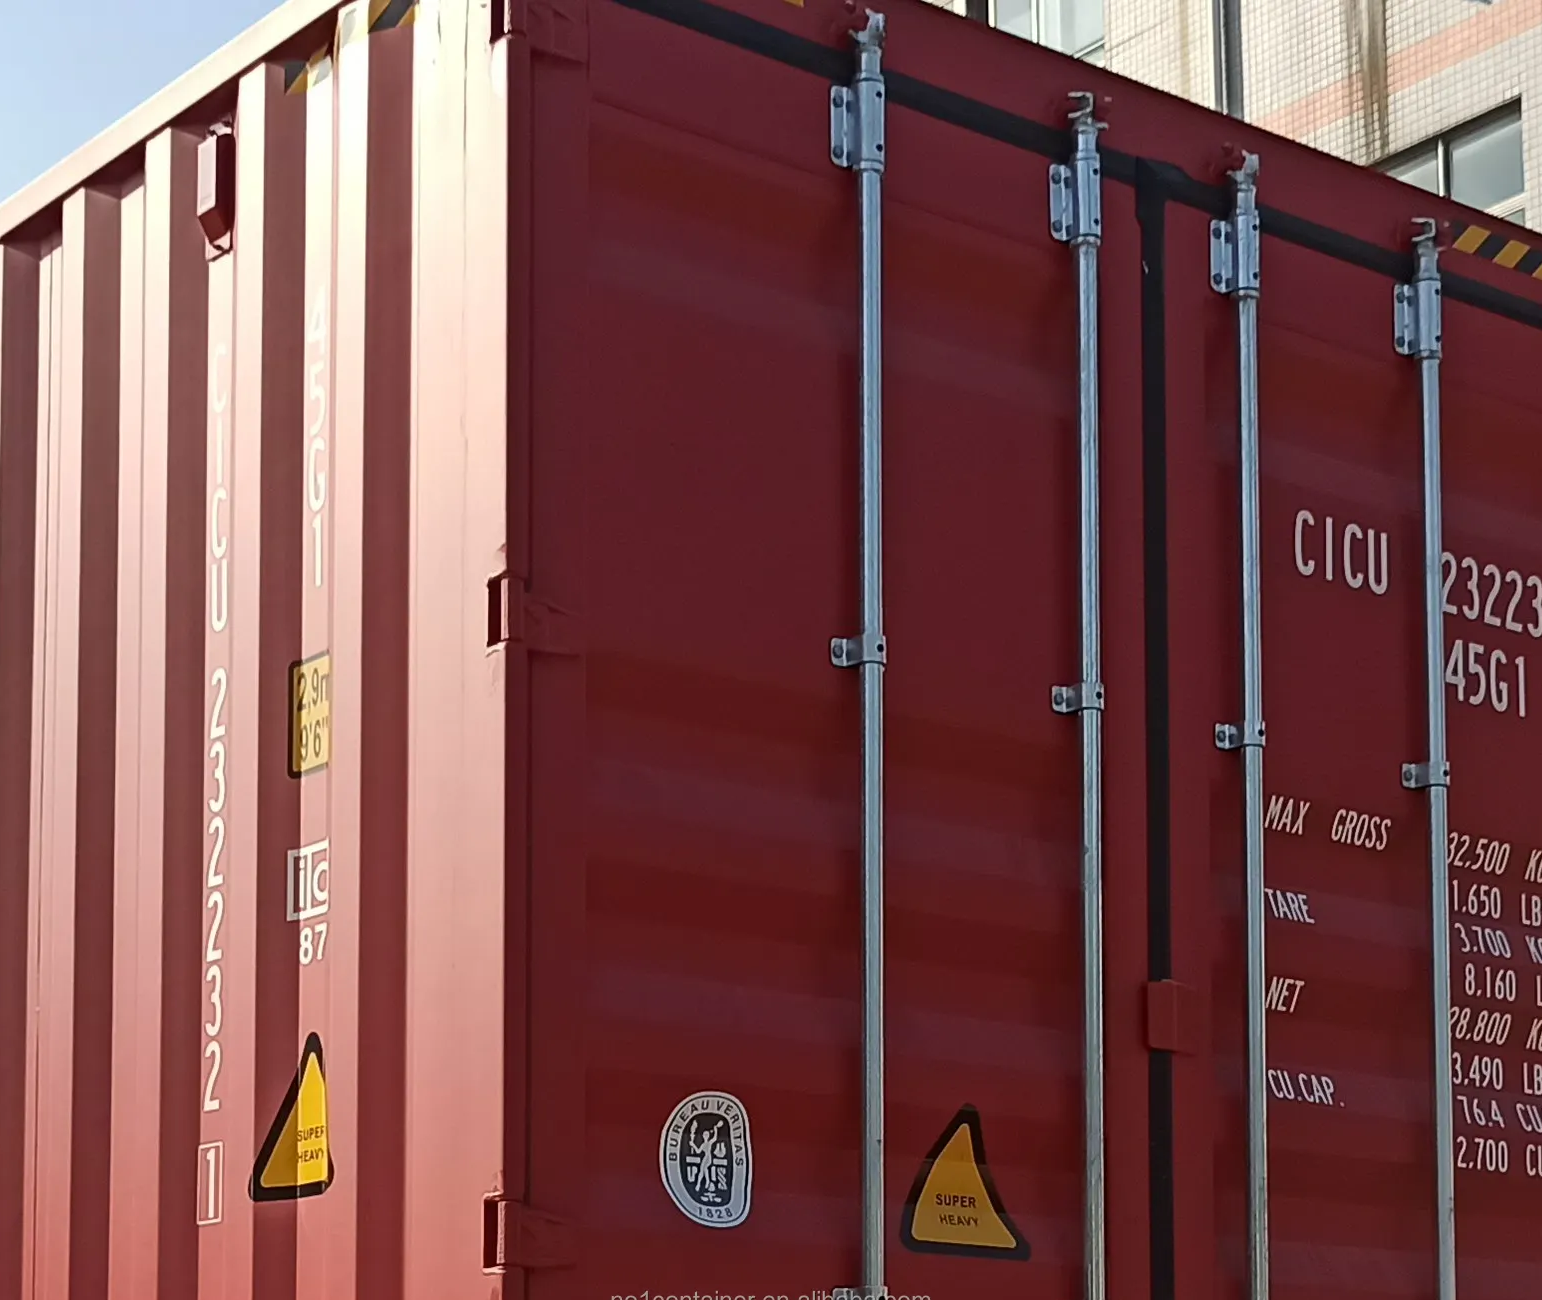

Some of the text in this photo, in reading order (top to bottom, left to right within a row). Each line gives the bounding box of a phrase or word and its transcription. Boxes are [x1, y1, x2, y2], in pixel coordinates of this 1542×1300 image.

[305, 284, 327, 588] 45G1
[209, 342, 228, 634] CICU
[1294, 509, 1389, 595] CICU
[1444, 639, 1526, 718] 45G1
[1264, 794, 1311, 836] MAX
[1331, 808, 1392, 851] GROSS
[202, 666, 227, 1113] 232232
[1264, 887, 1316, 925] TARE
[299, 922, 328, 966] 87
[1265, 976, 1305, 1014] NET
[1465, 962, 1517, 1002] 8,160
[668, 1099, 744, 1167] BUREAU VERITAS
[1456, 1095, 1505, 1129] 76.4
[1456, 1135, 1509, 1173] 2,700
[698, 1206, 734, 1219] 1828
[935, 1192, 977, 1209] SUPER
[938, 1213, 979, 1228] HEAVY
